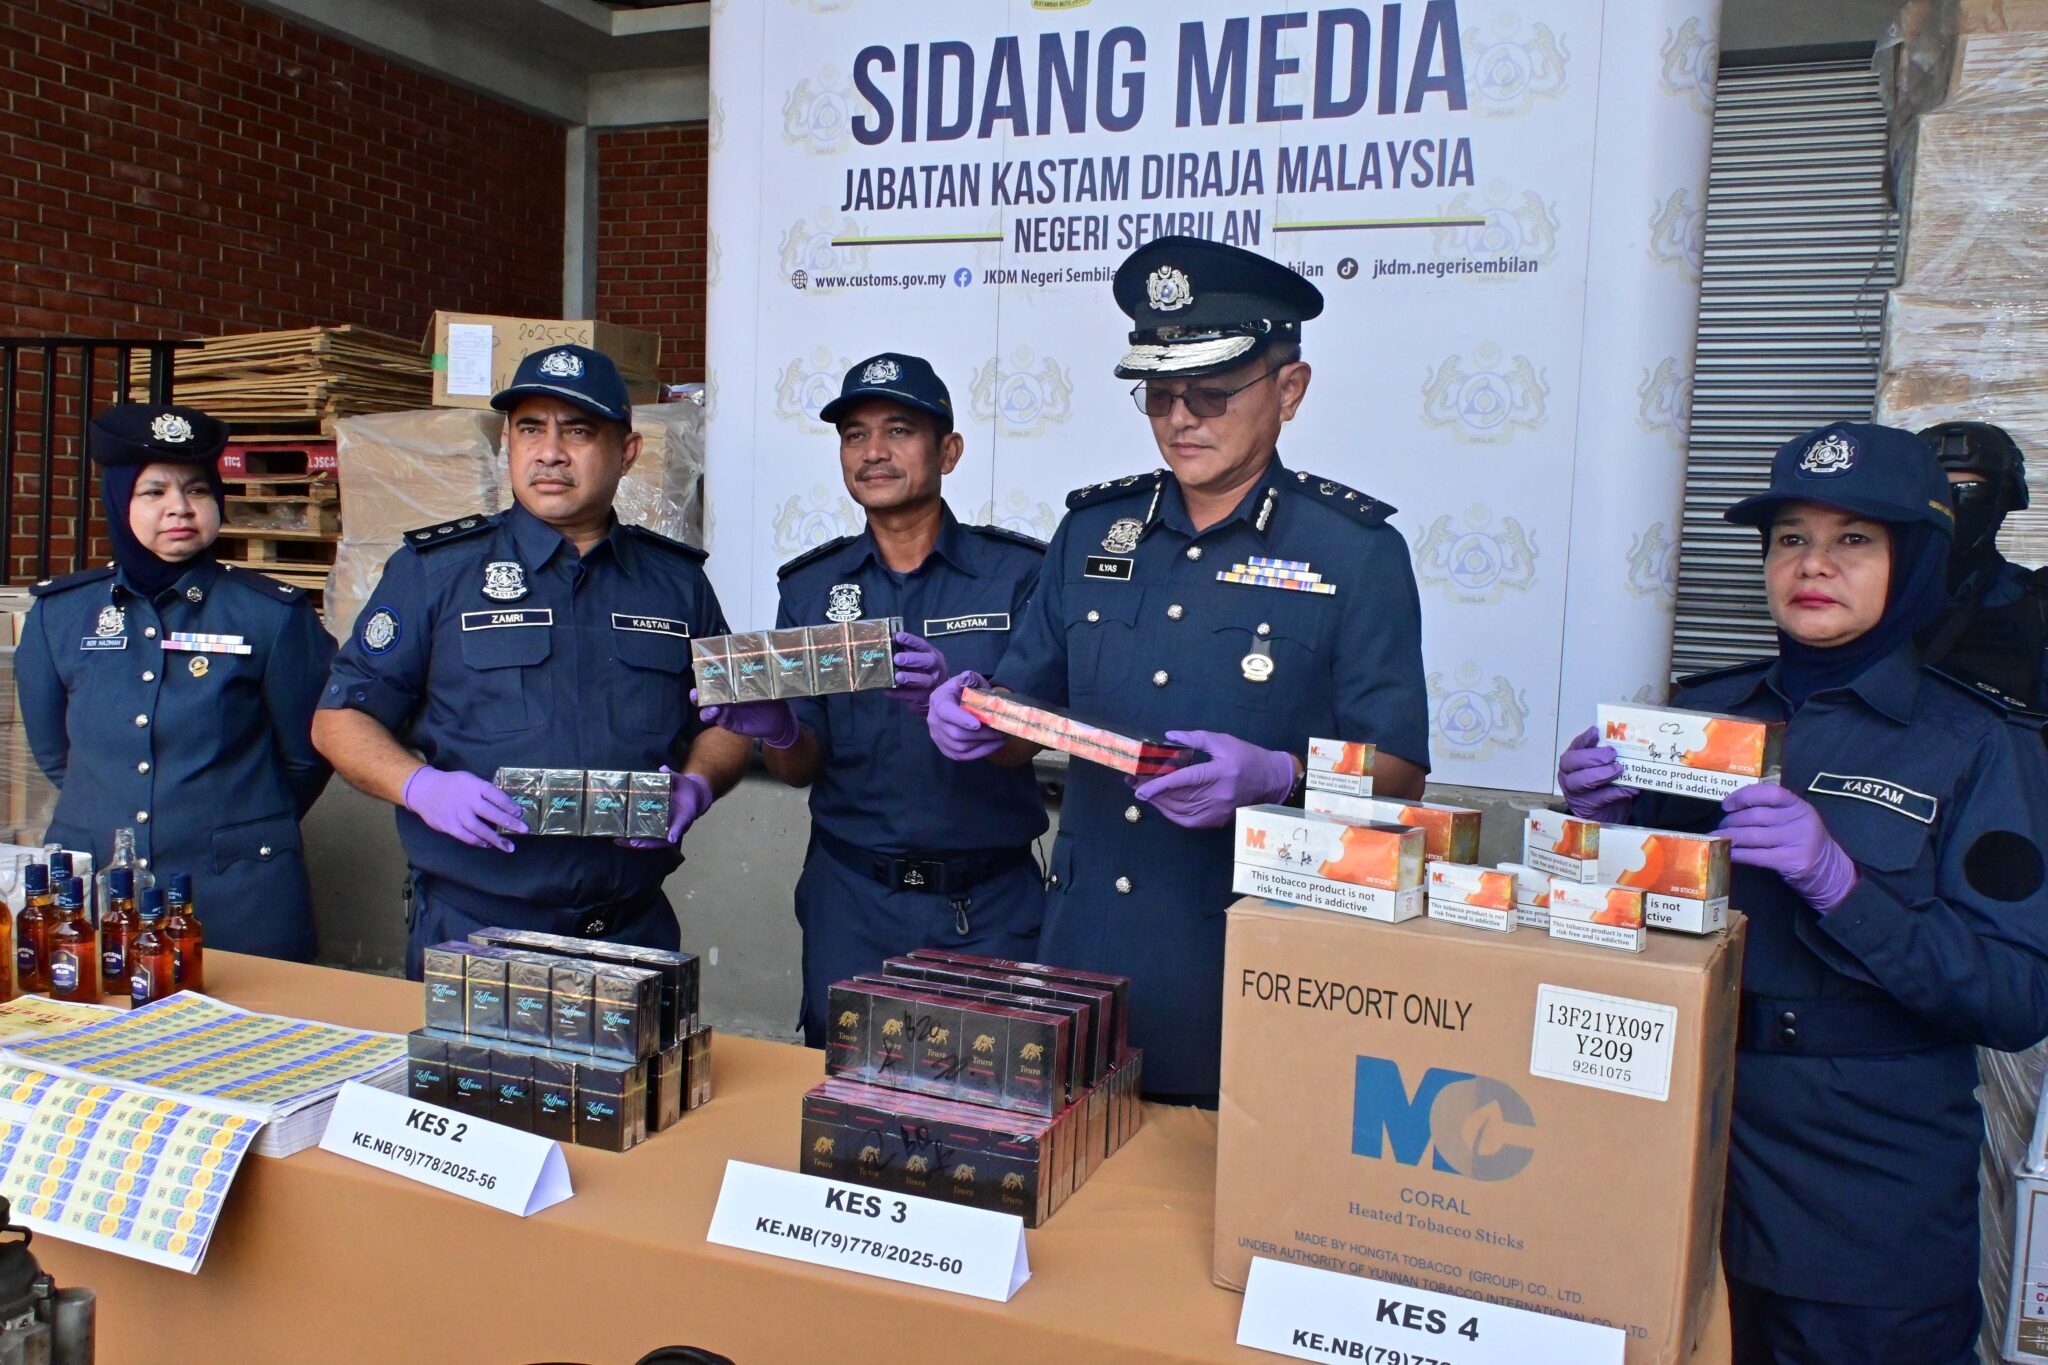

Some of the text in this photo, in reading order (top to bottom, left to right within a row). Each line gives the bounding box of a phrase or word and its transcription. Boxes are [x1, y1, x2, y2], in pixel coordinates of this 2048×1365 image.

[851, 0, 1468, 145] SIDANG MEDIA
[841, 137, 1475, 211] JABATAN KASTAM DIRAJA MALAYSIA
[1014, 215, 1109, 253] NEGERI
[815, 272, 946, 289] www.customs.gov.my
[983, 269, 1017, 285] JKDM
[1021, 268, 1063, 286] Negeri
[1066, 267, 1116, 284] Sembila
[1372, 257, 1538, 279] jkdm.negerisembilan
[1099, 564, 1117, 573] ILYAS
[491, 613, 523, 624] ZAMRI
[633, 619, 670, 631] KASTAM
[946, 617, 988, 631] KASTAM
[1659, 722, 1684, 735] C2
[1632, 764, 1668, 777] tobacco
[1670, 771, 1707, 786] product
[1710, 775, 1718, 785] is
[1720, 779, 1738, 787] not
[1635, 775, 1652, 786] free
[1655, 779, 1672, 789] and
[1675, 781, 1683, 791] is
[1685, 784, 1729, 797] addictive
[1843, 781, 1904, 804] KASTAM
[1252, 870, 1375, 902] This tobacco product is not
[1257, 884, 1367, 913] risk free and is addictive
[1680, 886, 1699, 895] STICKS
[1466, 908, 1487, 917] product
[1647, 913, 1672, 924] ctive
[1651, 899, 1680, 911] is not
[1553, 920, 1564, 928] This
[1566, 922, 1590, 932] tobacco
[1591, 927, 1615, 936] product
[1568, 929, 1580, 937] free
[1582, 932, 1593, 940] and
[1602, 936, 1629, 946] addictive
[1242, 969, 1472, 1031] FOR EXPORT ONLY
[1547, 1003, 1664, 1043] 13F21YX097
[973, 1056, 994, 1067] Touro
[1576, 1034, 1633, 1063] Y209
[1020, 1065, 1041, 1076] Touro
[1572, 1060, 1631, 1082] 9261075
[406, 1108, 468, 1142] KES 2
[1351, 1054, 1536, 1182] MC
[352, 1131, 497, 1190] KE.NB(79)778/2025-56
[825, 1187, 907, 1223] KES 3
[1400, 1187, 1471, 1215] CORAL
[1349, 1202, 1524, 1250] Heated Tobacco Sticks
[755, 1217, 963, 1275] KE.NB(79)778/2025-60
[1238, 1236, 1277, 1255] UNDER
[1280, 1246, 1345, 1270] AUTHORITY
[1350, 1262, 1365, 1275] OF
[1368, 1266, 1418, 1288] YUNNAN
[1422, 1277, 1482, 1301] TOBACCO
[1294, 1231, 1327, 1247] MADE
[1332, 1239, 1346, 1250] BY
[1350, 1243, 1399, 1263] HONGTA
[1402, 1255, 1462, 1277] TOBACCO
[1469, 1270, 1524, 1293] (GROUP)
[1558, 1289, 1585, 1305] LTD.
[1376, 1298, 1479, 1341] KES 4
